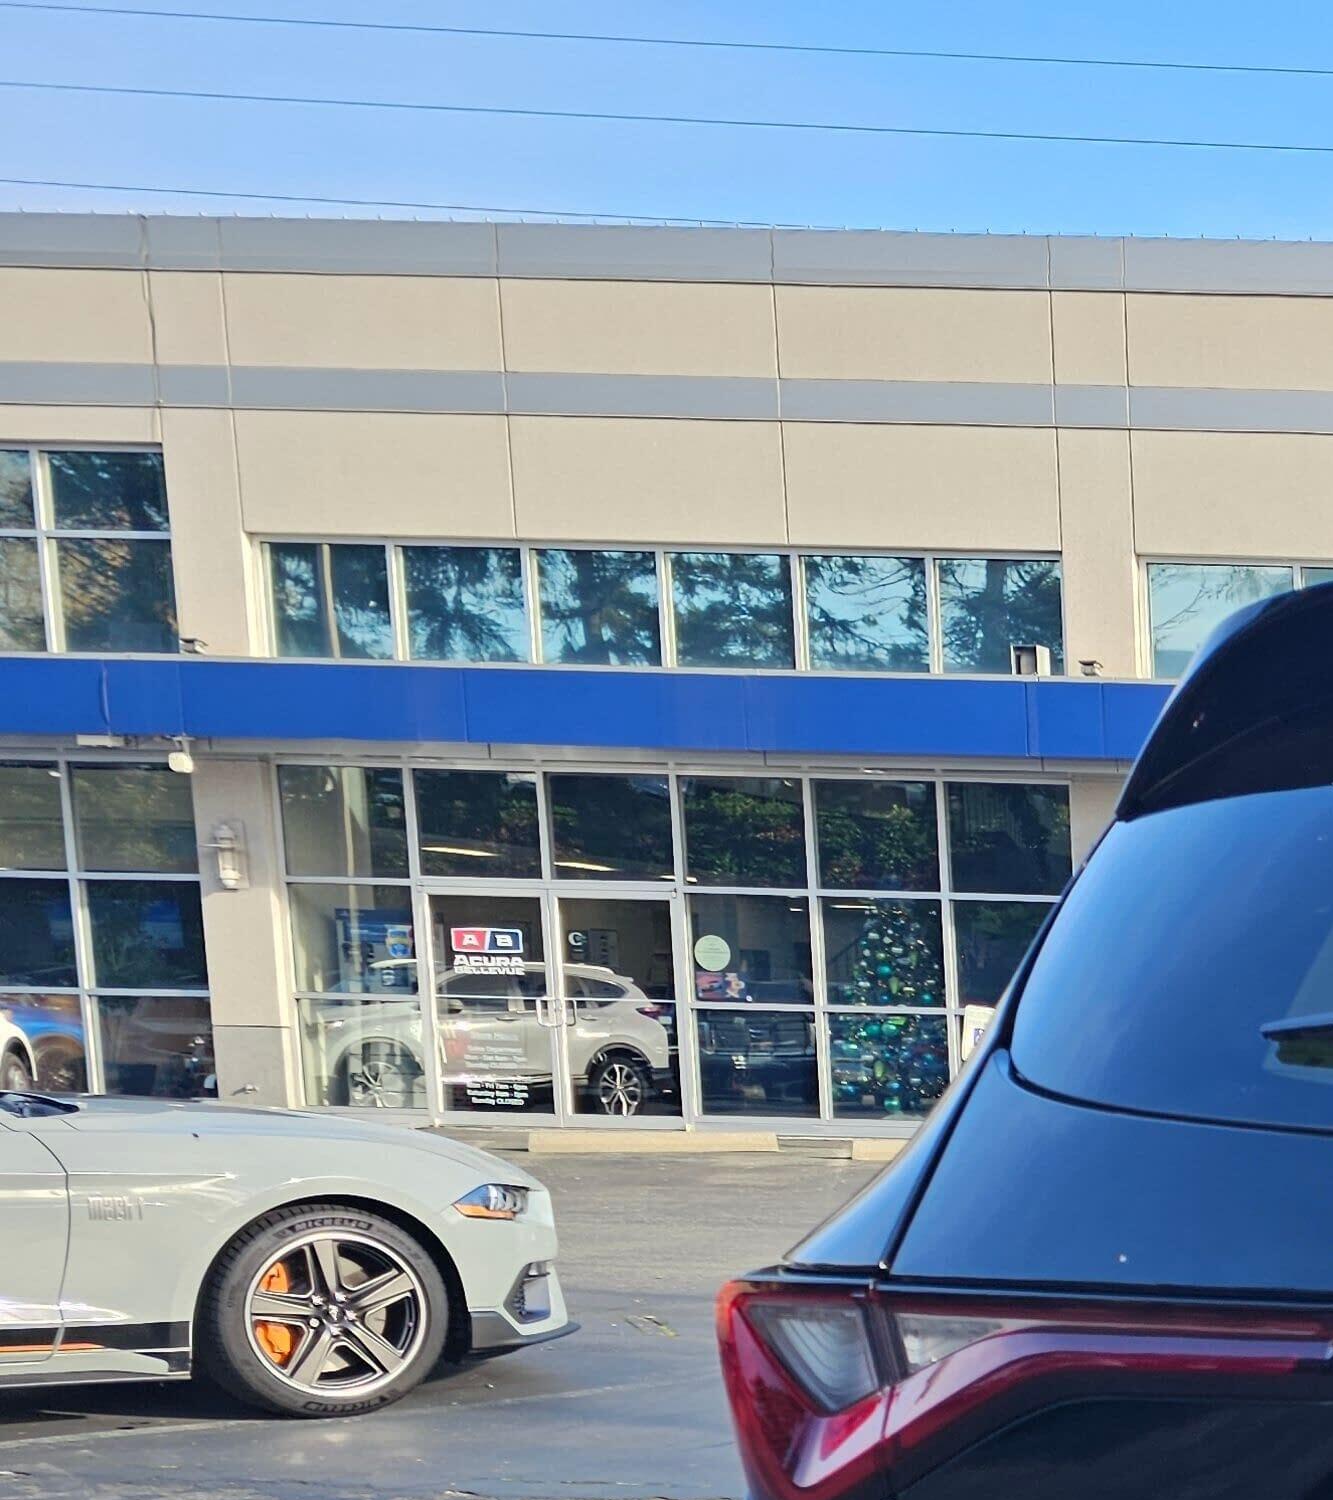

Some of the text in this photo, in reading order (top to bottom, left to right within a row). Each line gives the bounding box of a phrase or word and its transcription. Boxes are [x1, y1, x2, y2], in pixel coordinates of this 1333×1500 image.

[462, 934, 513, 947] A B
[454, 954, 525, 967] ACURA
[293, 1217, 371, 1232] MICHELIN
